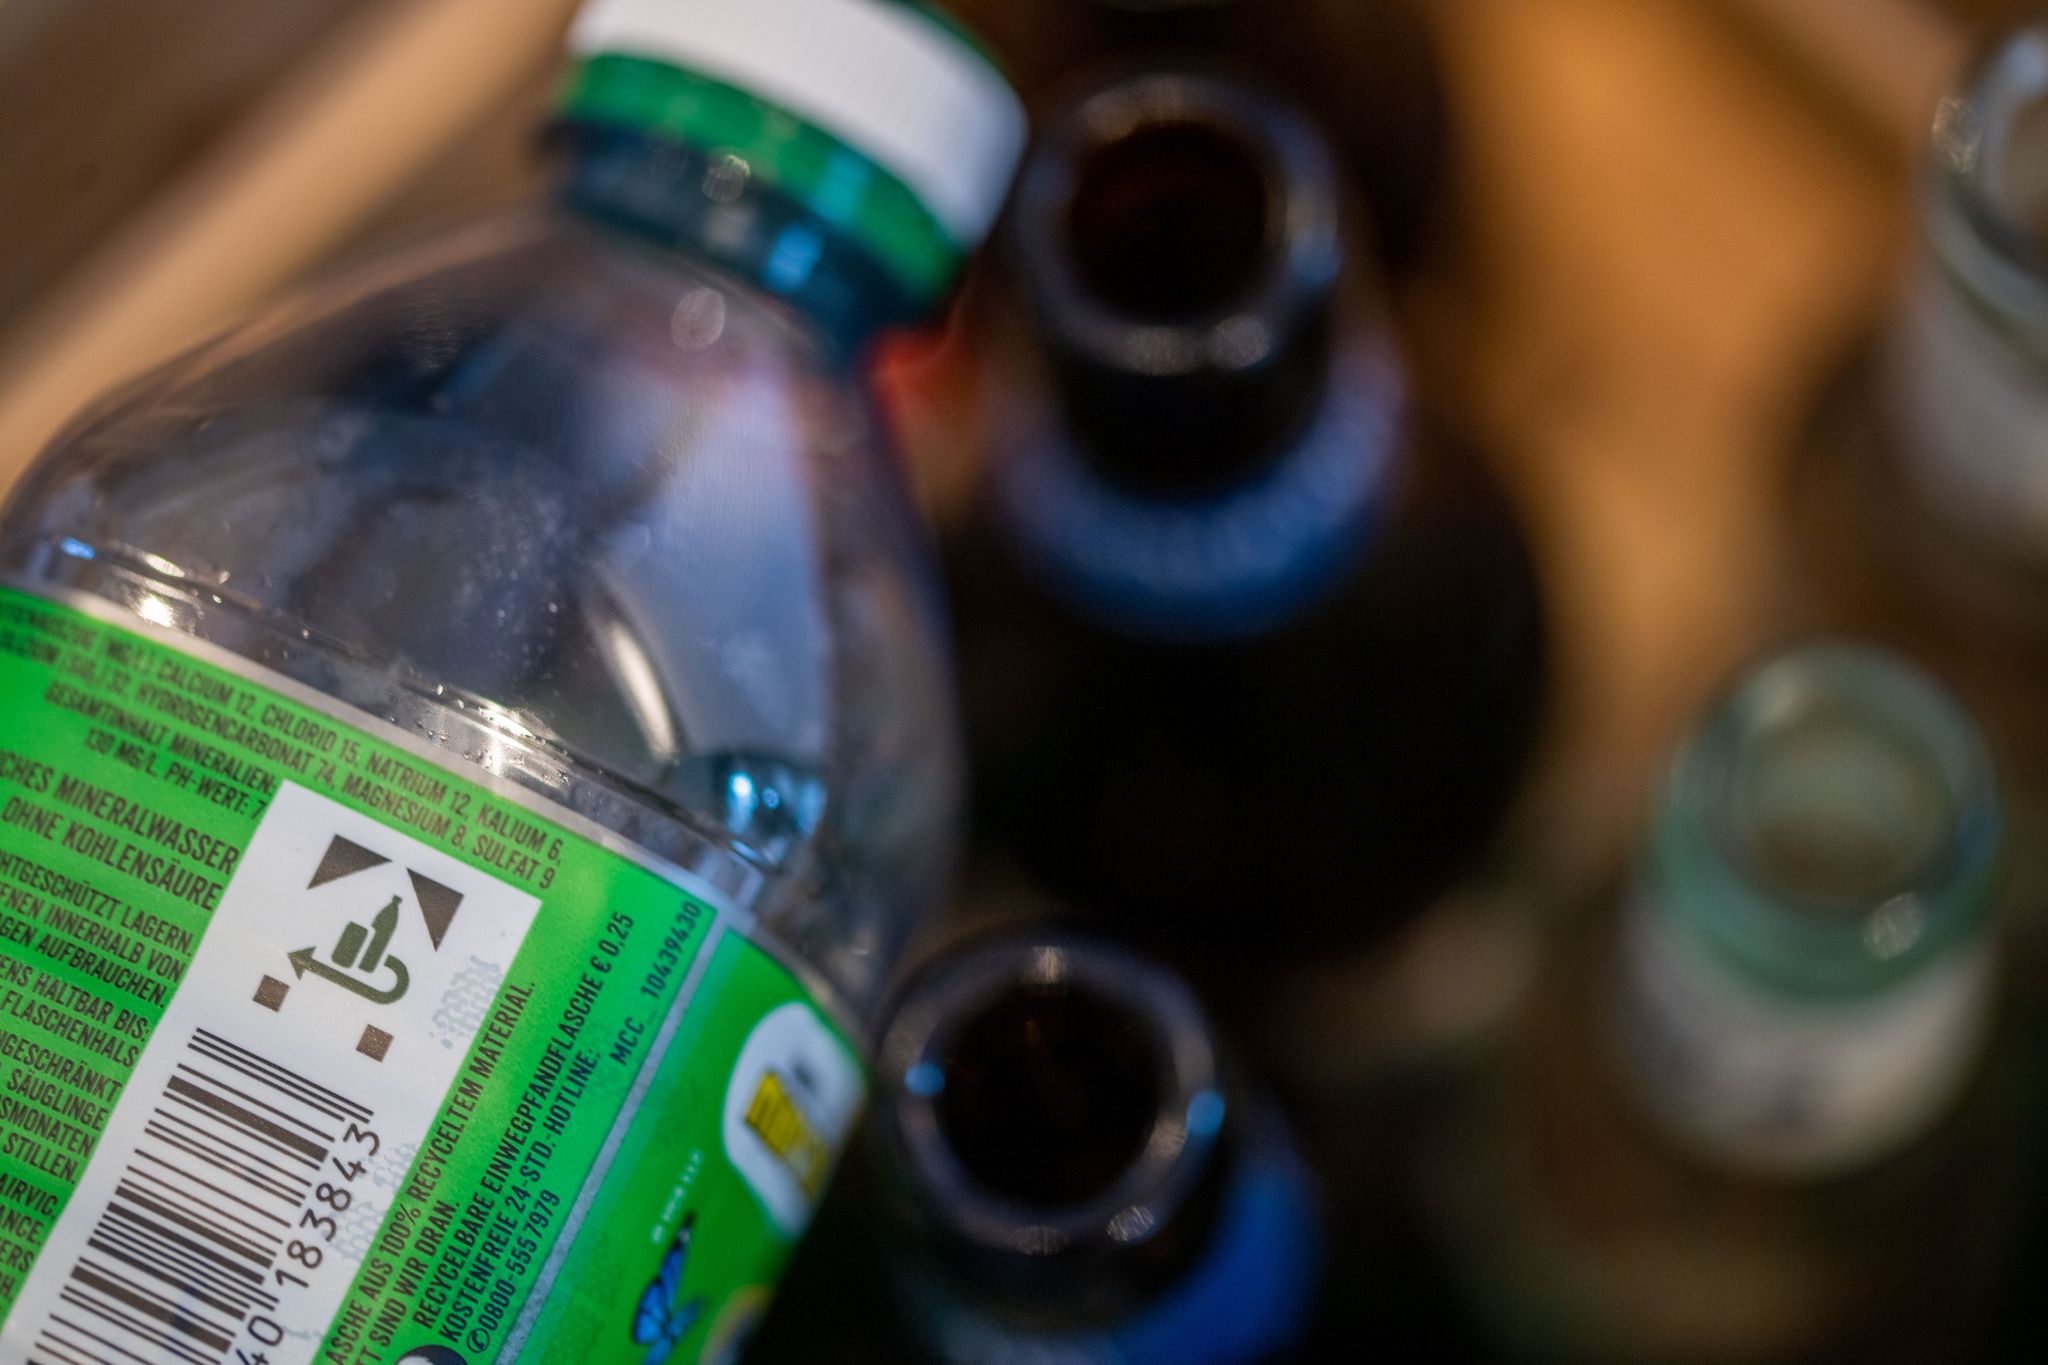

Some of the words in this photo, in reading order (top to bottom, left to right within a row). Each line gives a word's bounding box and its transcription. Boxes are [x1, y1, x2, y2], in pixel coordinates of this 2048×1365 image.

[250, 799, 268, 820] 7
[260, 704, 337, 752] CHLORID
[365, 751, 448, 804] NATRIUM
[476, 803, 548, 853] KALIUM
[1, 795, 63, 840] OHNE
[62, 822, 223, 912] KOHLENSÄURE
[54, 774, 240, 876] MINERALWASSER
[341, 772, 452, 840] MAGNESIUM
[472, 834, 541, 881] SULFAT
[539, 867, 556, 890] 9
[44, 904, 145, 964] INNERHALB
[146, 949, 186, 983] VON
[120, 905, 194, 957] LAGERN.
[590, 956, 612, 973] €
[598, 912, 634, 957] 0,25
[32, 972, 114, 1024] HALTBAR
[113, 1009, 150, 1042] BIS:
[35, 934, 167, 1009] AUFBRAUCHEN.
[0, 989, 140, 1068] FLASCHENHALS
[6, 1068, 109, 1132] SÄUGLINGE
[480, 973, 603, 1194] EINWEGPFANDFLASCHE
[0, 1094, 96, 1158] SMONATEN
[2, 1132, 78, 1185] STILLEN.
[358, 1257, 393, 1301] AUS
[377, 1203, 421, 1257] 100%
[405, 1077, 484, 1203] RECYCELTEM
[468, 983, 535, 1079] MATERIAL.
[438, 1211, 518, 1343] KOSTENFREIE
[504, 1050, 600, 1213] 24-STD.-HOTLINE:
[368, 1298, 407, 1347] SIND
[393, 1257, 429, 1297] WIR
[414, 1200, 460, 1257] DRAN.
[412, 1192, 495, 1329] RECYCELBARE
